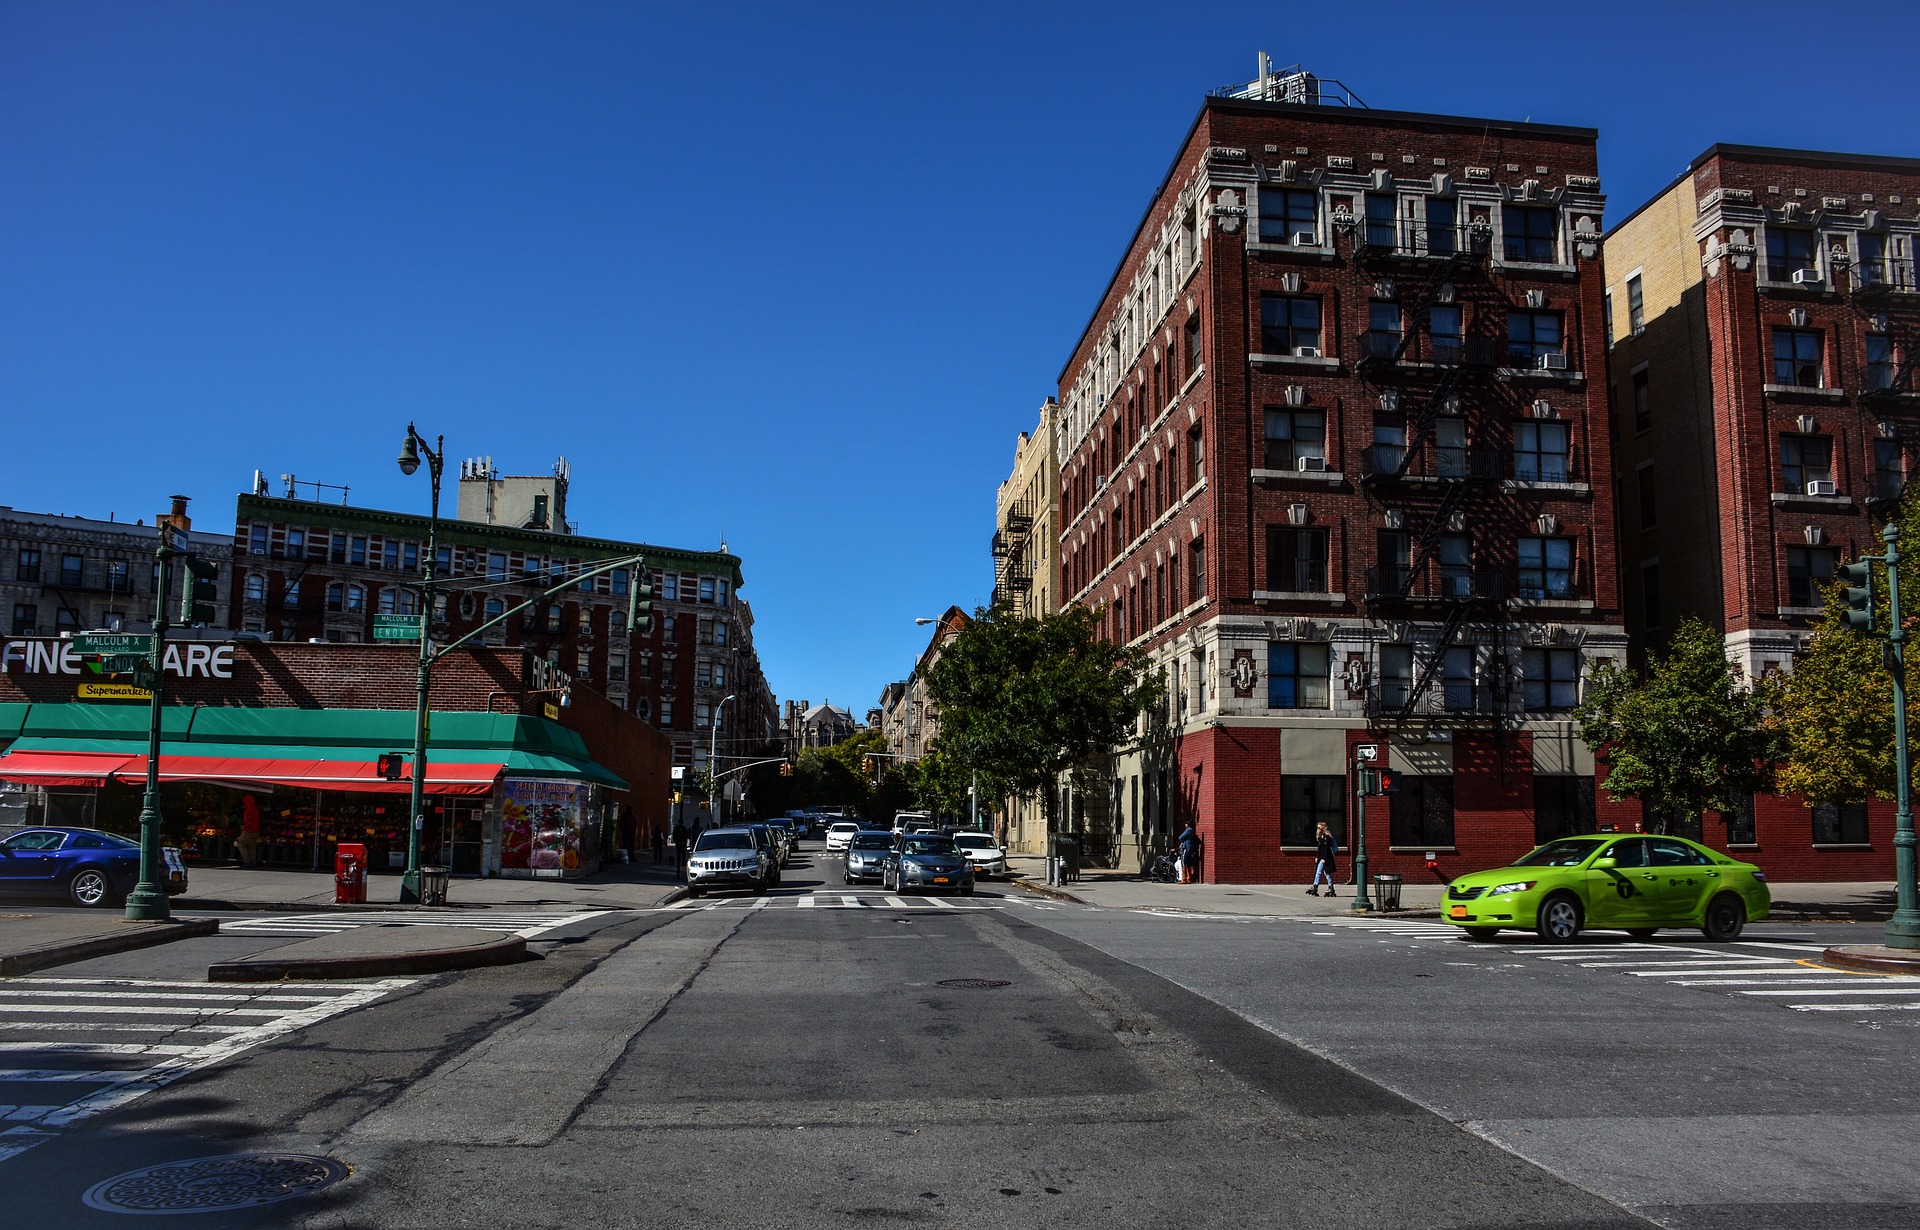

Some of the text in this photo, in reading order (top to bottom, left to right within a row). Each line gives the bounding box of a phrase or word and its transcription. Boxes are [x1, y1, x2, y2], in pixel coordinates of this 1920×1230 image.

[373, 628, 405, 638] LENOX
[85, 636, 140, 646] MALCOLM X
[2, 641, 235, 678] FINE ARE
[103, 656, 134, 671] LENOX
[85, 684, 152, 696] Supermarkets
[515, 782, 545, 791] SPECIAL
